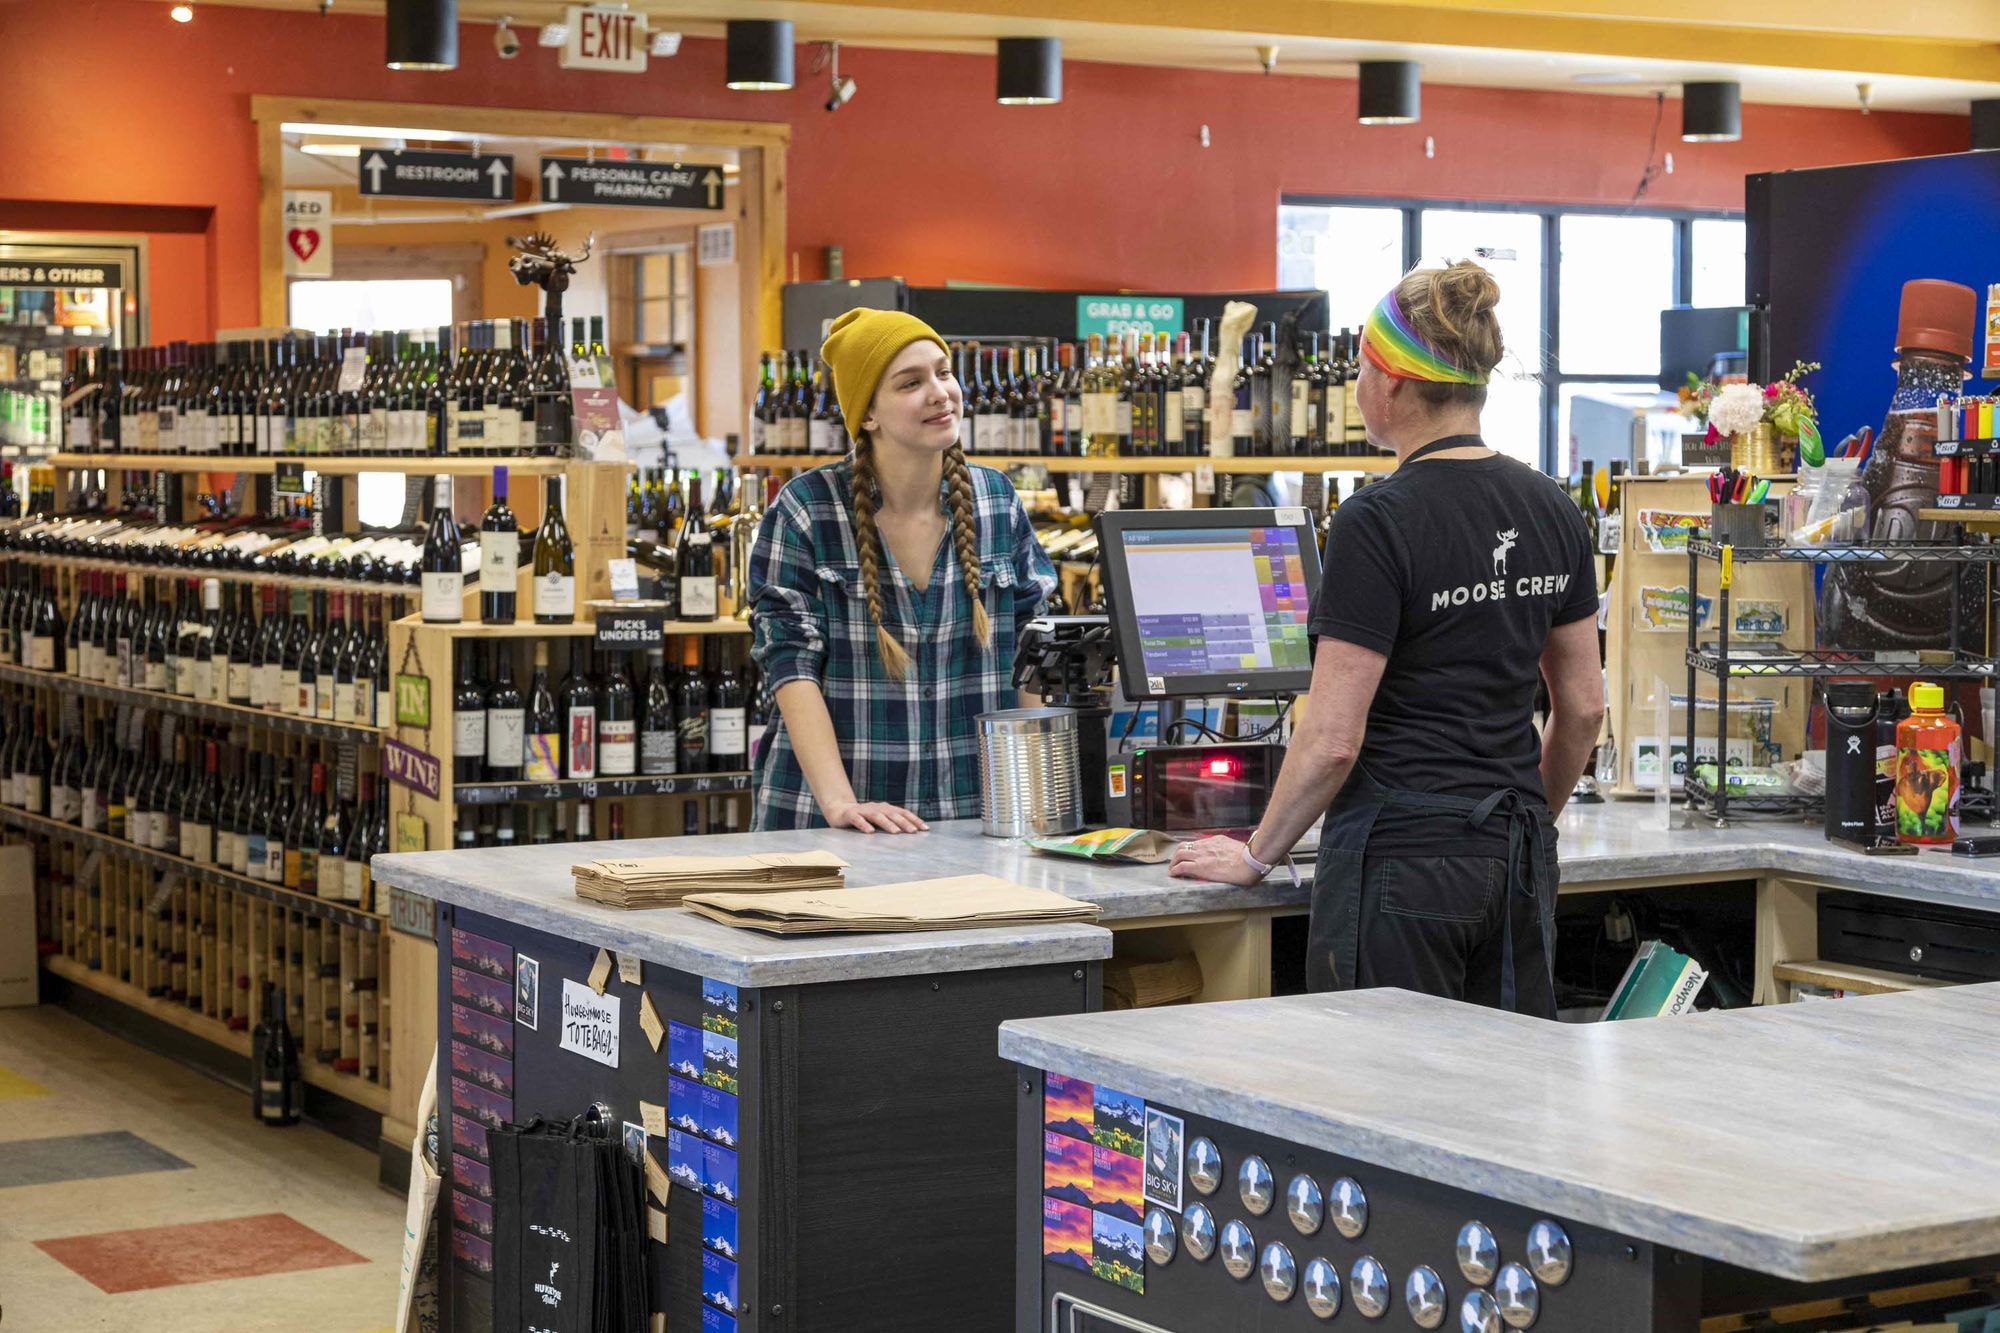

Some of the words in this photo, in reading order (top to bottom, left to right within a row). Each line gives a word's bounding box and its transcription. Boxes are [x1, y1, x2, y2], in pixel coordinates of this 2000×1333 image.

[582, 12, 636, 60] EXIT
[395, 165, 479, 183] RESTROOM
[571, 166, 648, 185] PERSONAL
[650, 170, 696, 187] CARE/
[594, 182, 674, 200] PHARMACY
[285, 202, 322, 214] AED
[33, 268, 46, 282] &
[48, 268, 104, 283] OTHER
[1087, 302, 1132, 319] GRAB
[1134, 304, 1146, 318] &
[1149, 304, 1174, 320] GO
[1107, 320, 1154, 334] FOOD
[1431, 580, 1506, 612] MOOSE
[1516, 574, 1570, 597] CREW
[614, 620, 647, 630] PICKS
[600, 630, 638, 641] UNDER
[640, 630, 661, 641] $25
[400, 681, 425, 715] IN
[1696, 746, 1714, 754] BIG
[386, 744, 439, 794] WINE
[390, 894, 436, 938] TRUTH
[1668, 972, 1701, 1016] Newpor
[526, 1006, 534, 1018] SKY
[1146, 1173, 1160, 1188] BIG
[1161, 1179, 1178, 1196] SKY
